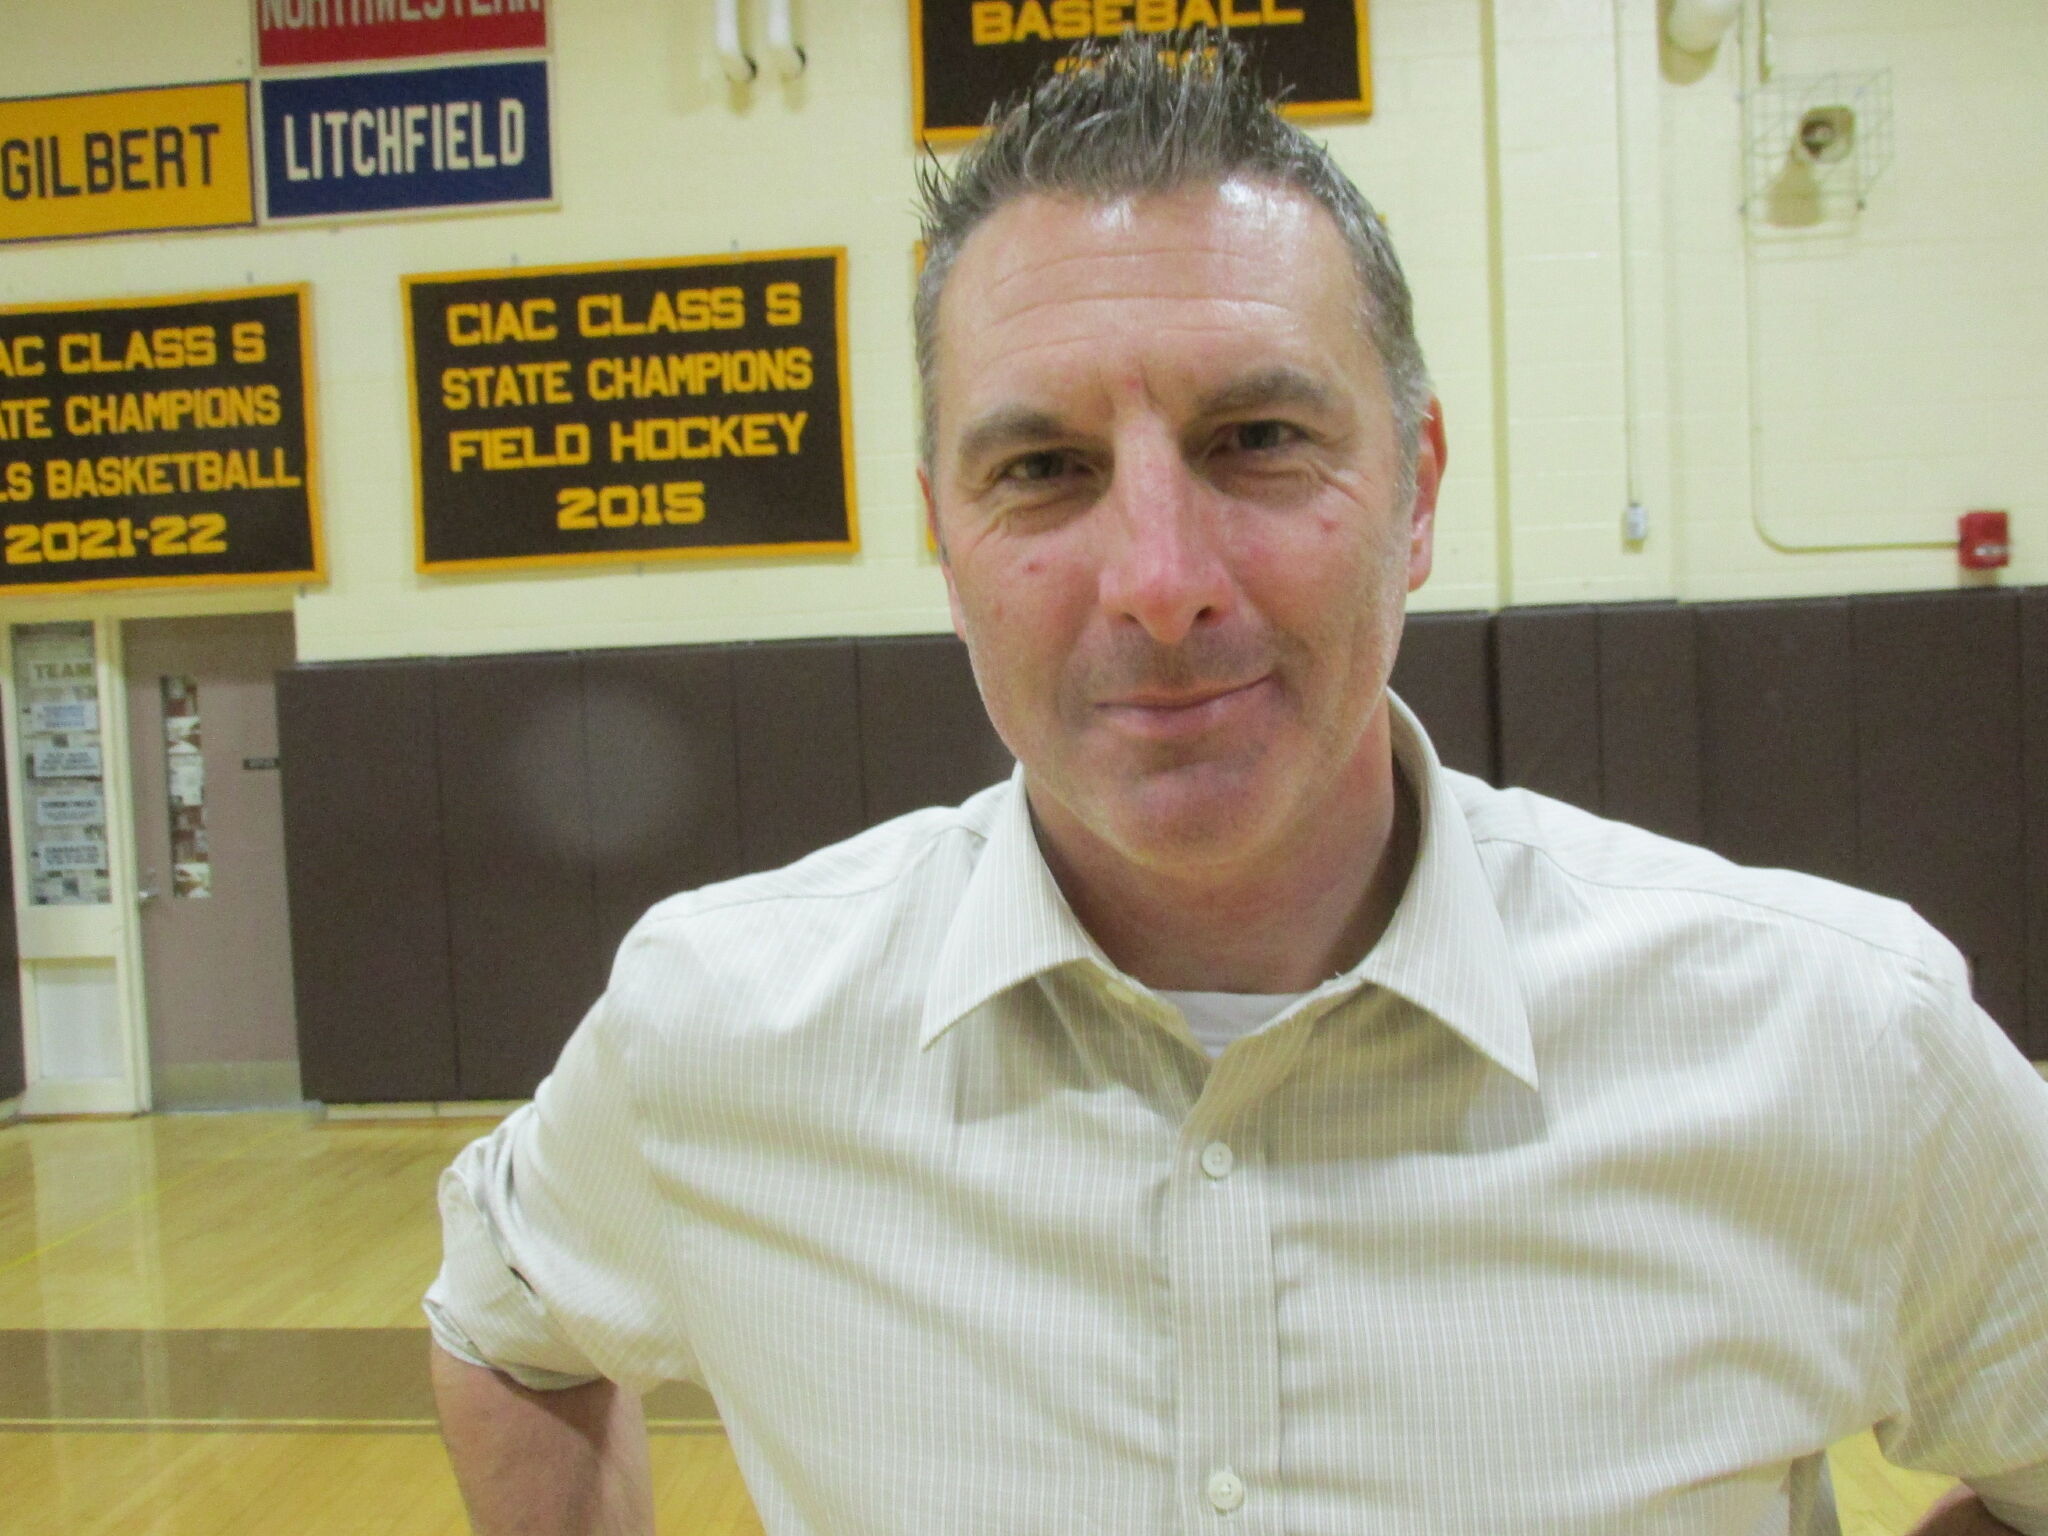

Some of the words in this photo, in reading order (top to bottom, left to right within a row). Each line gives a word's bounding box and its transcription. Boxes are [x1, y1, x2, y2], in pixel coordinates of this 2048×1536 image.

[971, 0, 1305, 45] BASEBALL
[0, 123, 220, 201] GILBERT
[284, 98, 525, 182] LITCHFIELD
[445, 297, 558, 347] CIAC
[577, 286, 746, 338] CLASS
[764, 281, 803, 327] S
[58, 325, 217, 374] CLASS
[231, 321, 267, 364] S
[441, 360, 574, 411] STATE
[586, 346, 814, 402] CHAMPIONS
[64, 383, 281, 436] CHAMPIONS
[448, 422, 591, 473] FIELD
[609, 411, 809, 464] HOCKEY
[0, 461, 34, 503] S
[45, 447, 302, 501] BASKETBALL
[556, 480, 706, 531] 2015
[3, 512, 228, 565] 2021-22
[33, 662, 93, 679] TEAM
